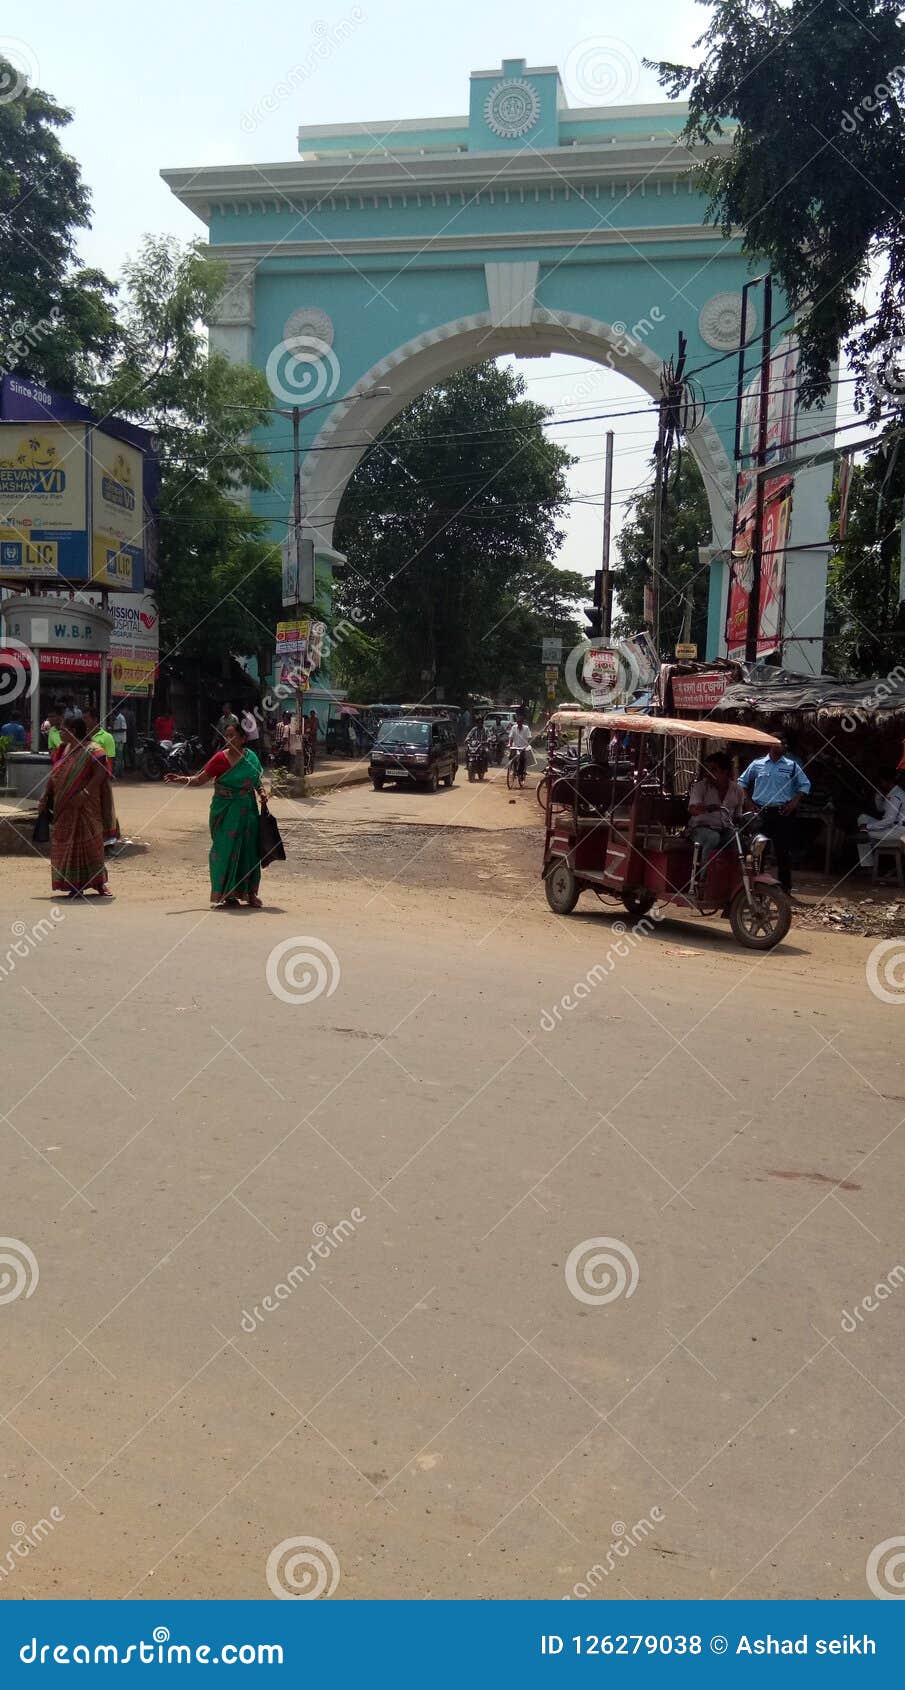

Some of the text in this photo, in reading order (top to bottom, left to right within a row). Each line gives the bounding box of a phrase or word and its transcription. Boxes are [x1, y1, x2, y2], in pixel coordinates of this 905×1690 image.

[9, 380, 32, 398] Since
[0, 471, 37, 481] EEVAN
[40, 471, 62, 492] VI
[26, 545, 53, 564] LIC
[112, 618, 142, 632] OSPITAL
